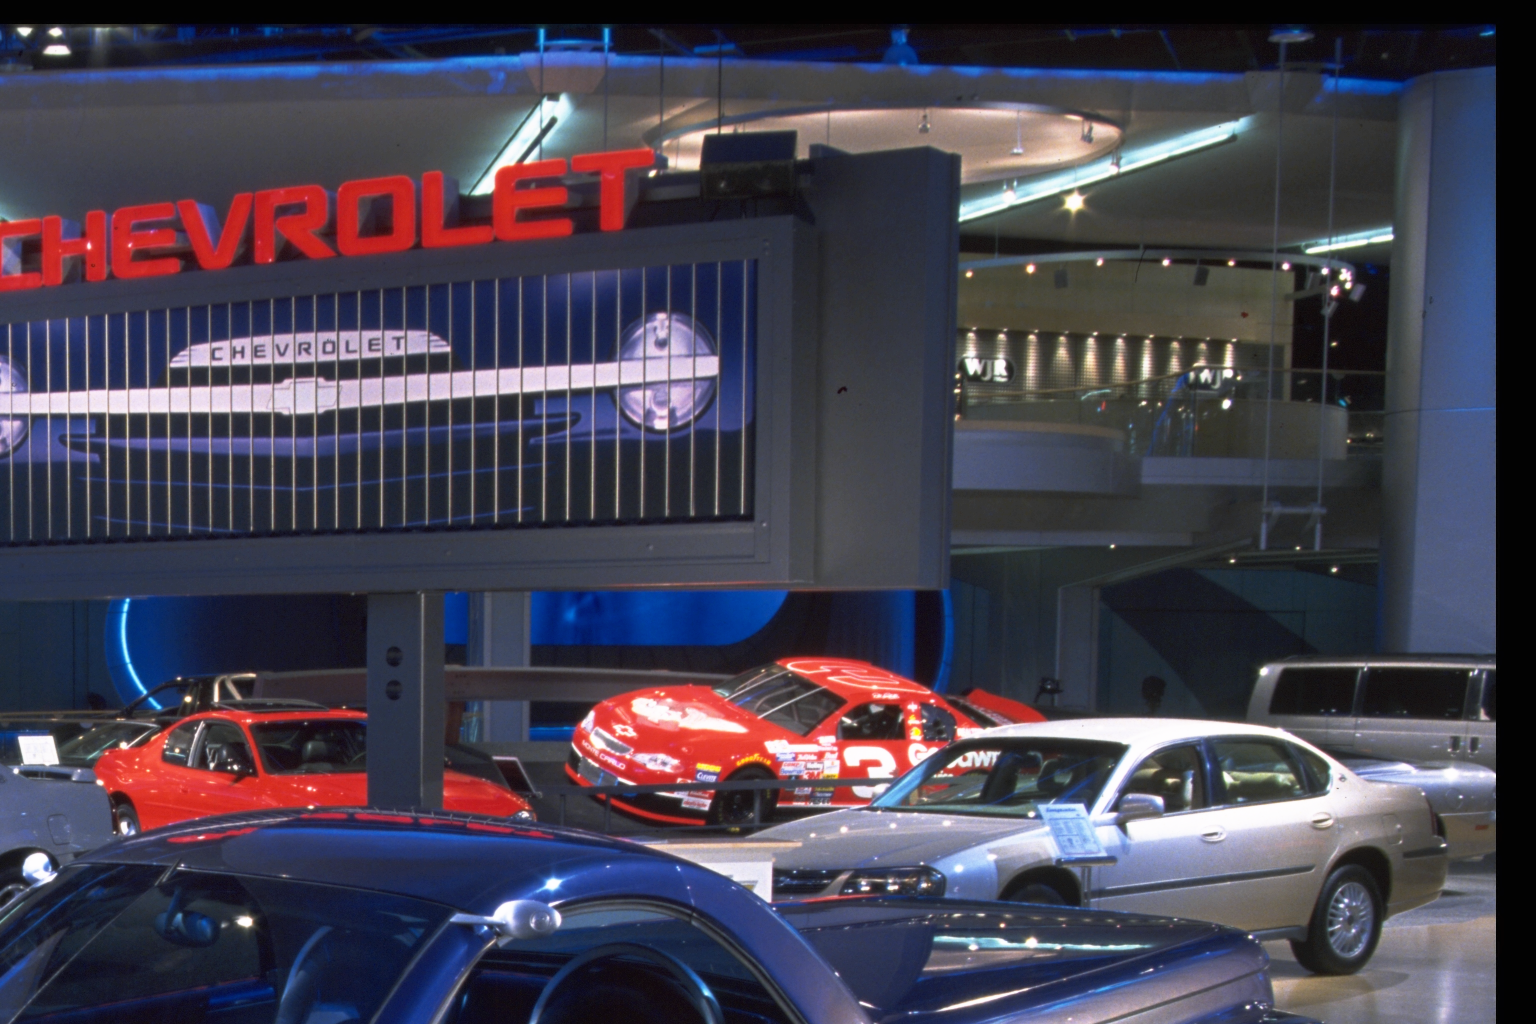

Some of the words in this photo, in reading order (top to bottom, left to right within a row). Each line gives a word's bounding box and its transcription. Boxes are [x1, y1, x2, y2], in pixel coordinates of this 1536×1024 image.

[210, 335, 406, 362] CHEVROLET
[964, 358, 1008, 381] WJR
[581, 739, 600, 757] MONTE
[599, 753, 626, 770] CARLO
[843, 746, 897, 798] 3
